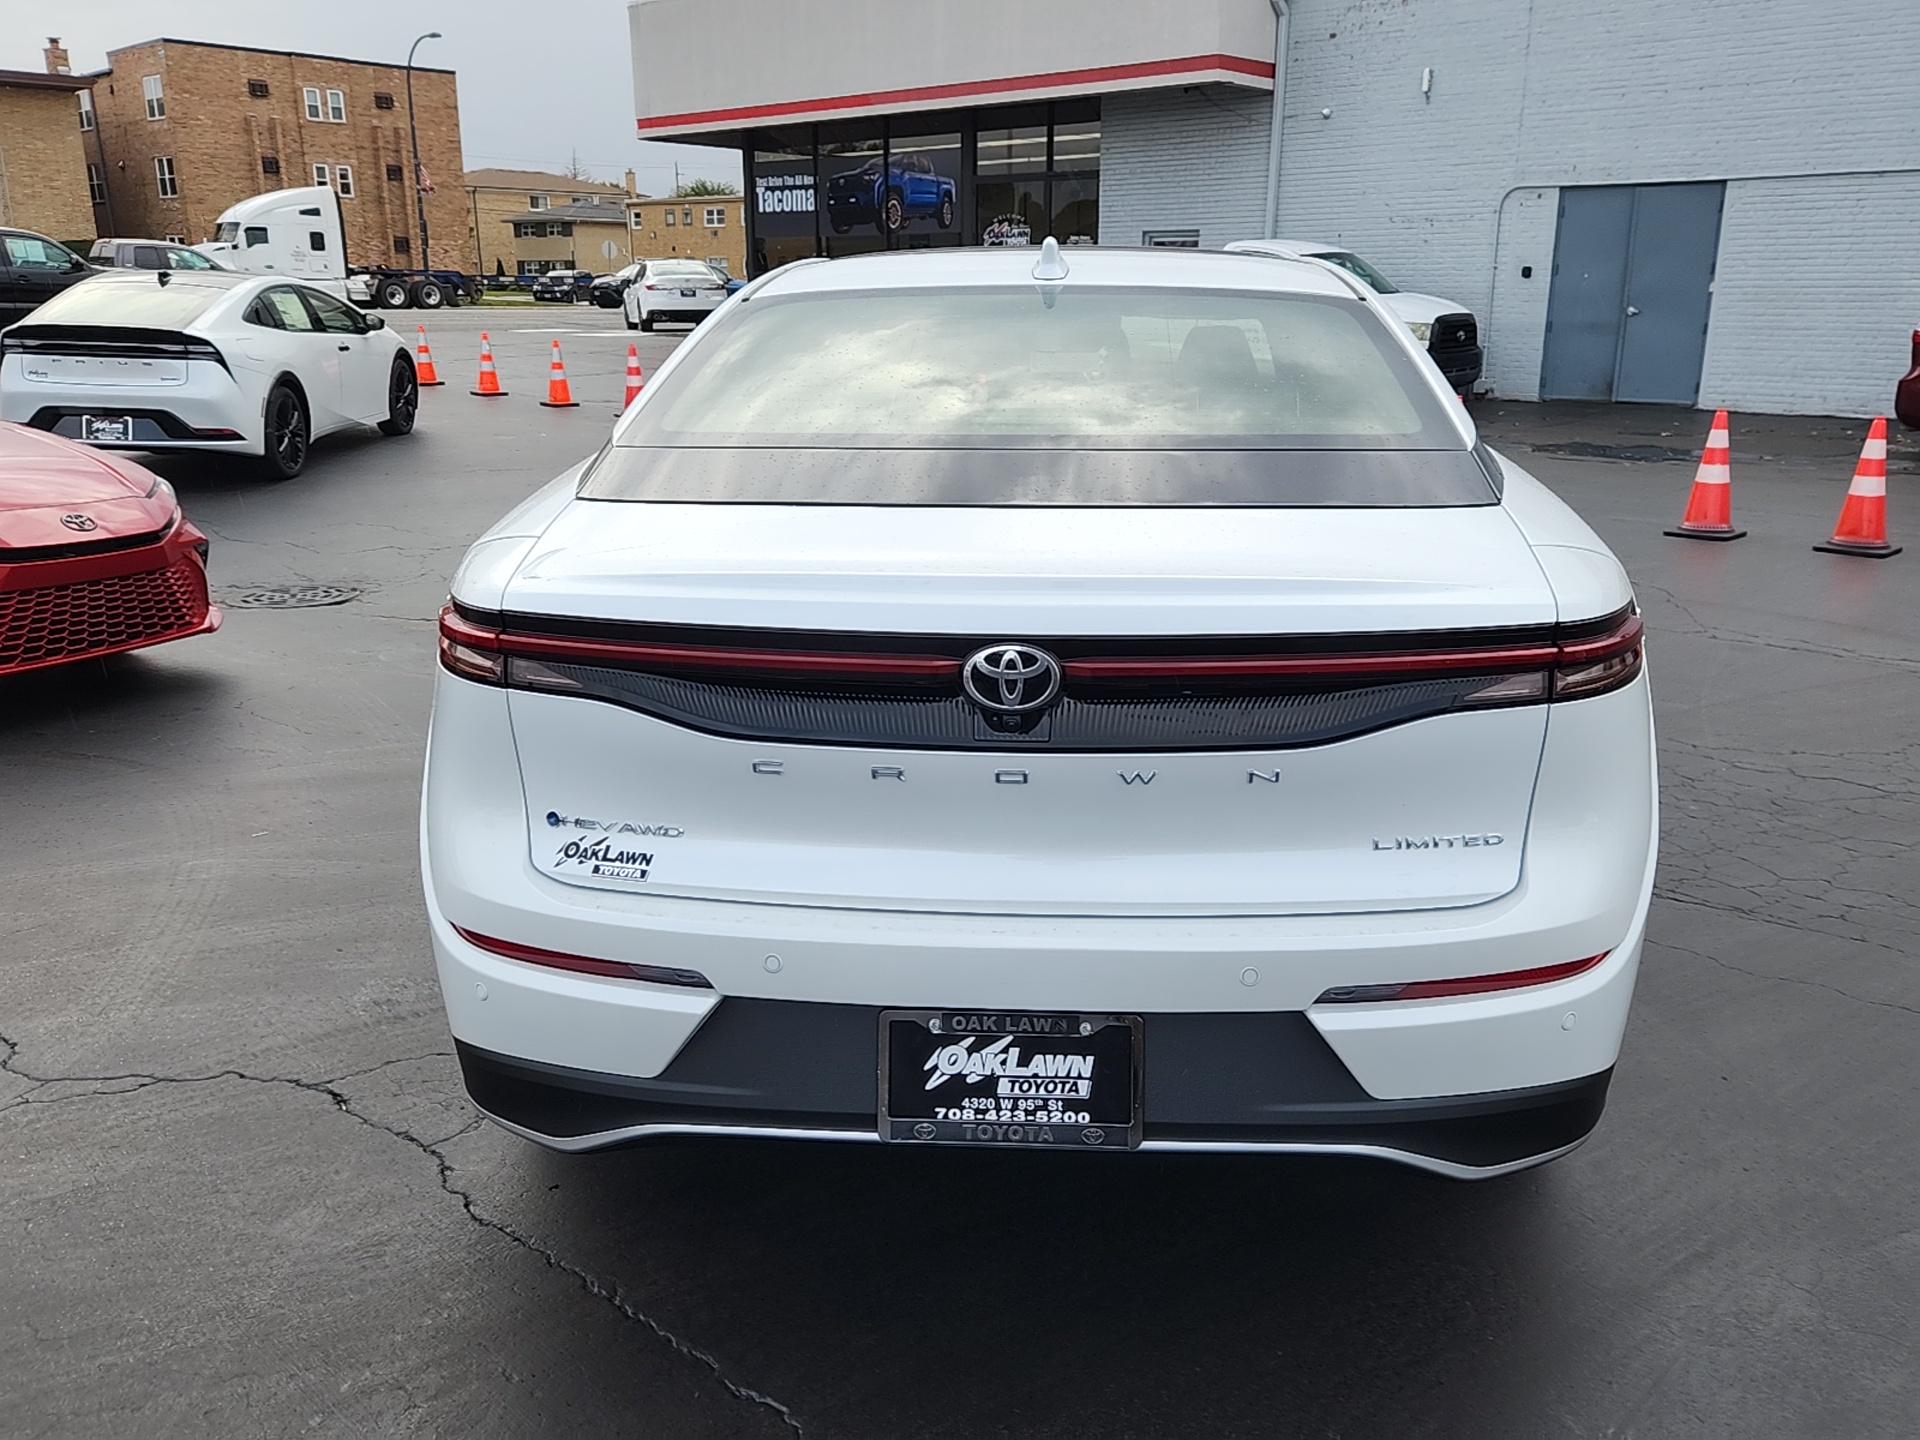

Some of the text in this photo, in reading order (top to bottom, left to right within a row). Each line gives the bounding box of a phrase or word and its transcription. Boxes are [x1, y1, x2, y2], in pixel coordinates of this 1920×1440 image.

[755, 186, 815, 213] Tacoma
[752, 759, 1281, 785] CROWN
[617, 822, 685, 838] AWD
[1372, 833, 1504, 851] LIMITED
[598, 865, 642, 879] TOYOTA
[952, 1015, 1068, 1032] OAK LAWN
[1008, 1079, 1080, 1095] TOYOTA
[961, 1097, 1063, 1111] 4320 W 95th St
[934, 1108, 1091, 1123] 708-423-5200
[962, 1124, 1055, 1142] TOYOTA
